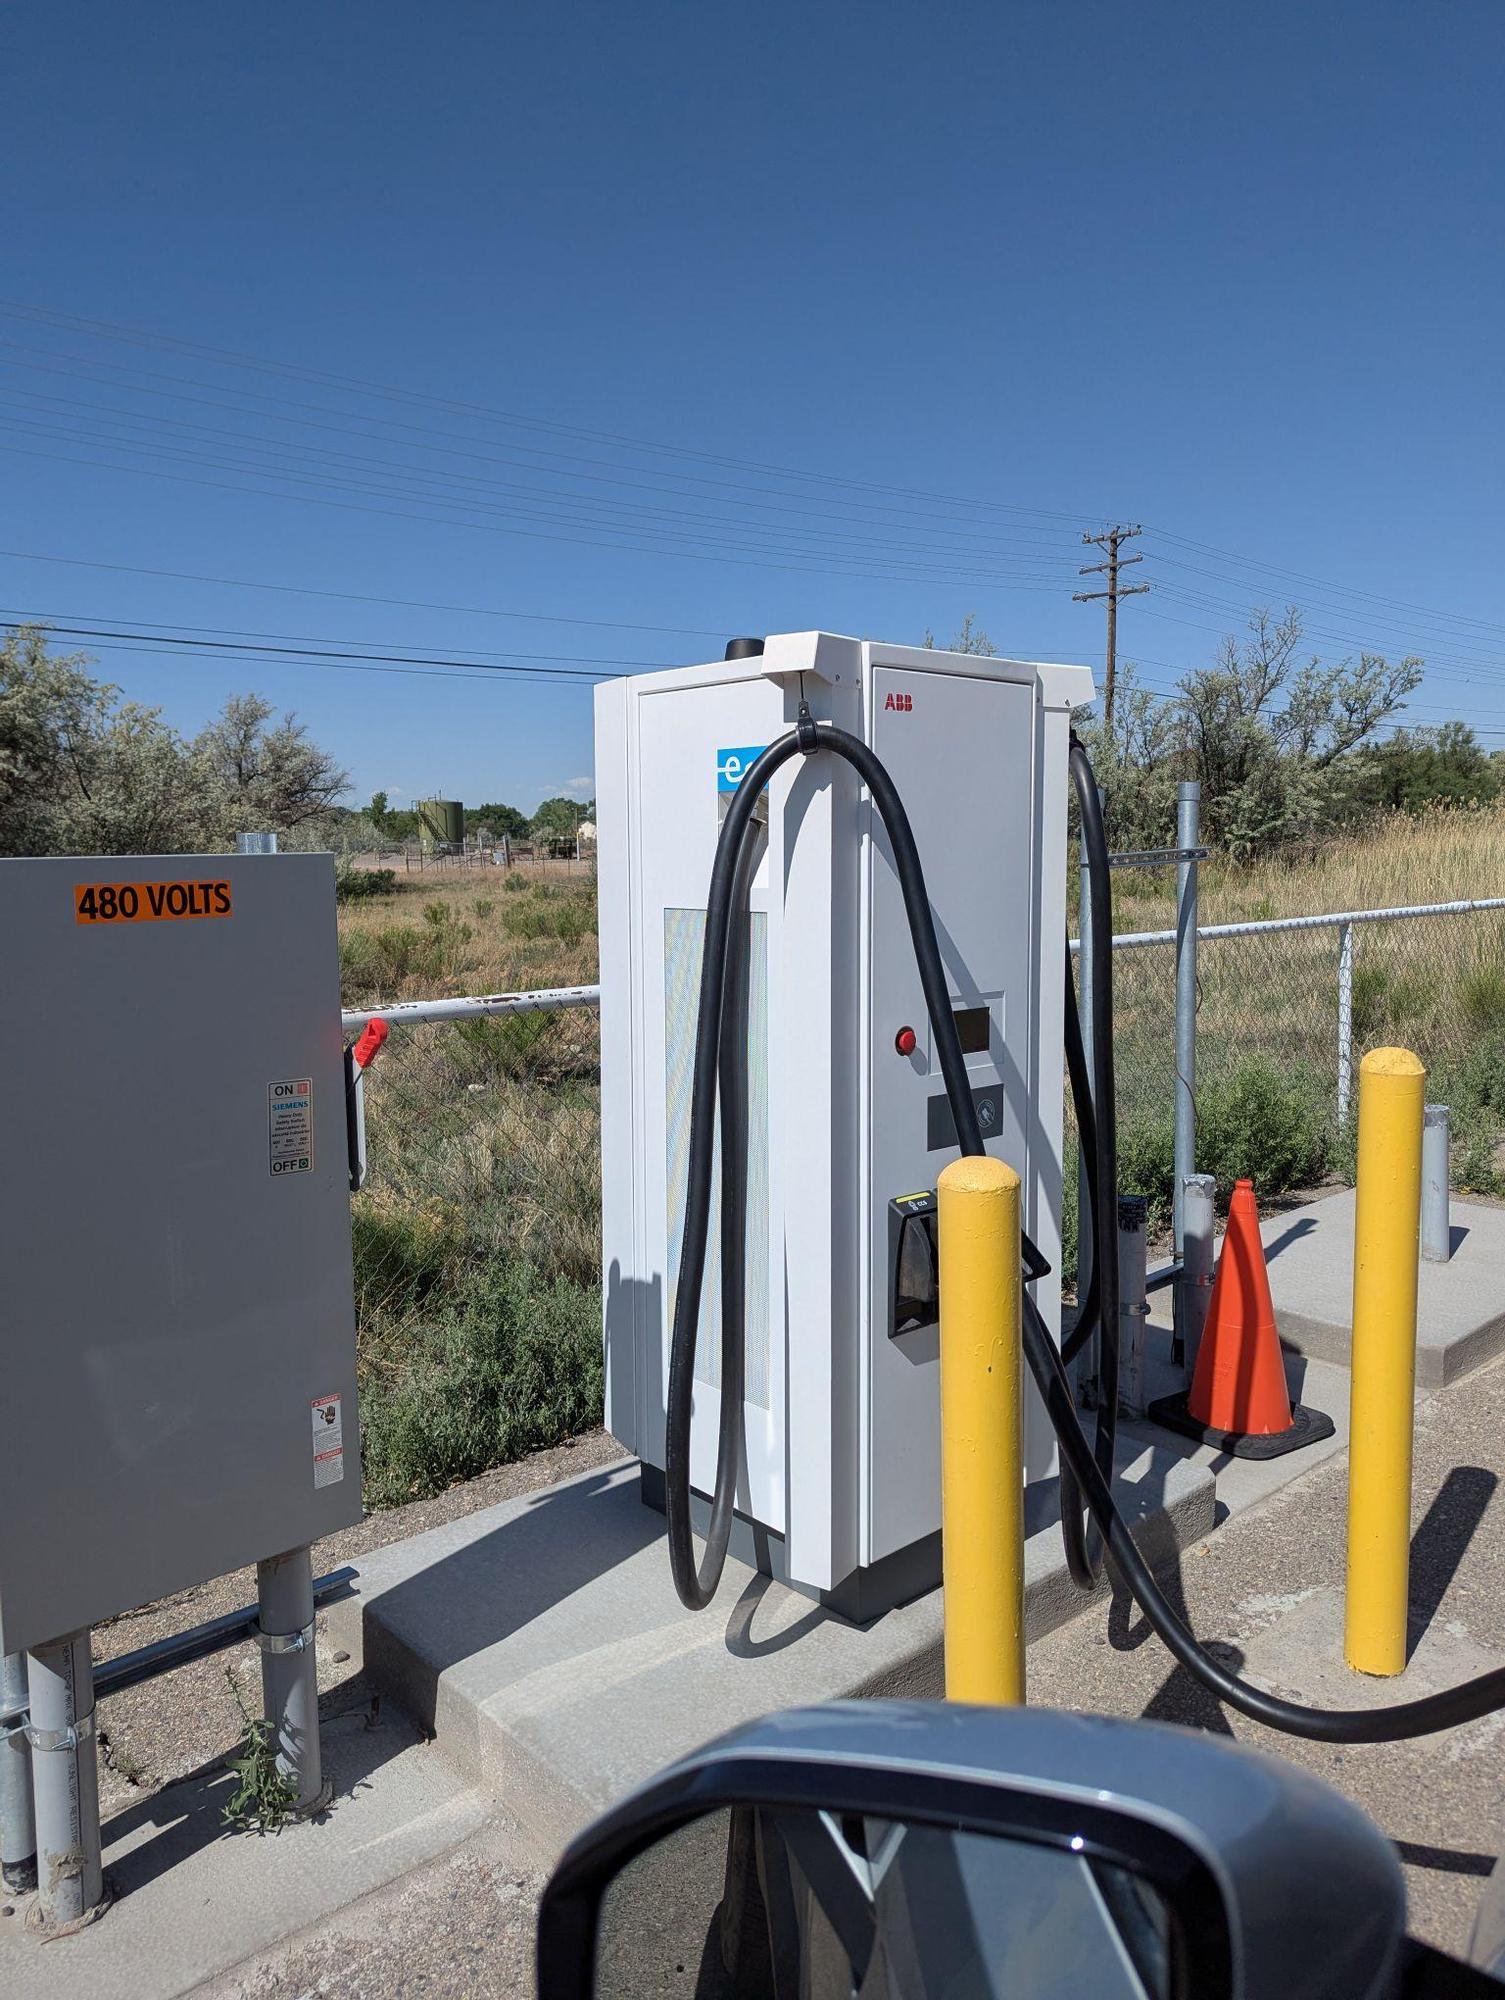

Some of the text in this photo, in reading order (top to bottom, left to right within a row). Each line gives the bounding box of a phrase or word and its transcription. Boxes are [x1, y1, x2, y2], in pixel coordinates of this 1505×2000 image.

[884, 693, 913, 711] ABB
[79, 883, 231, 920] 480 VOLTS
[274, 1085, 294, 1096] ON
[272, 1101, 309, 1111] SIEMENS
[272, 1160, 298, 1172] OFF
